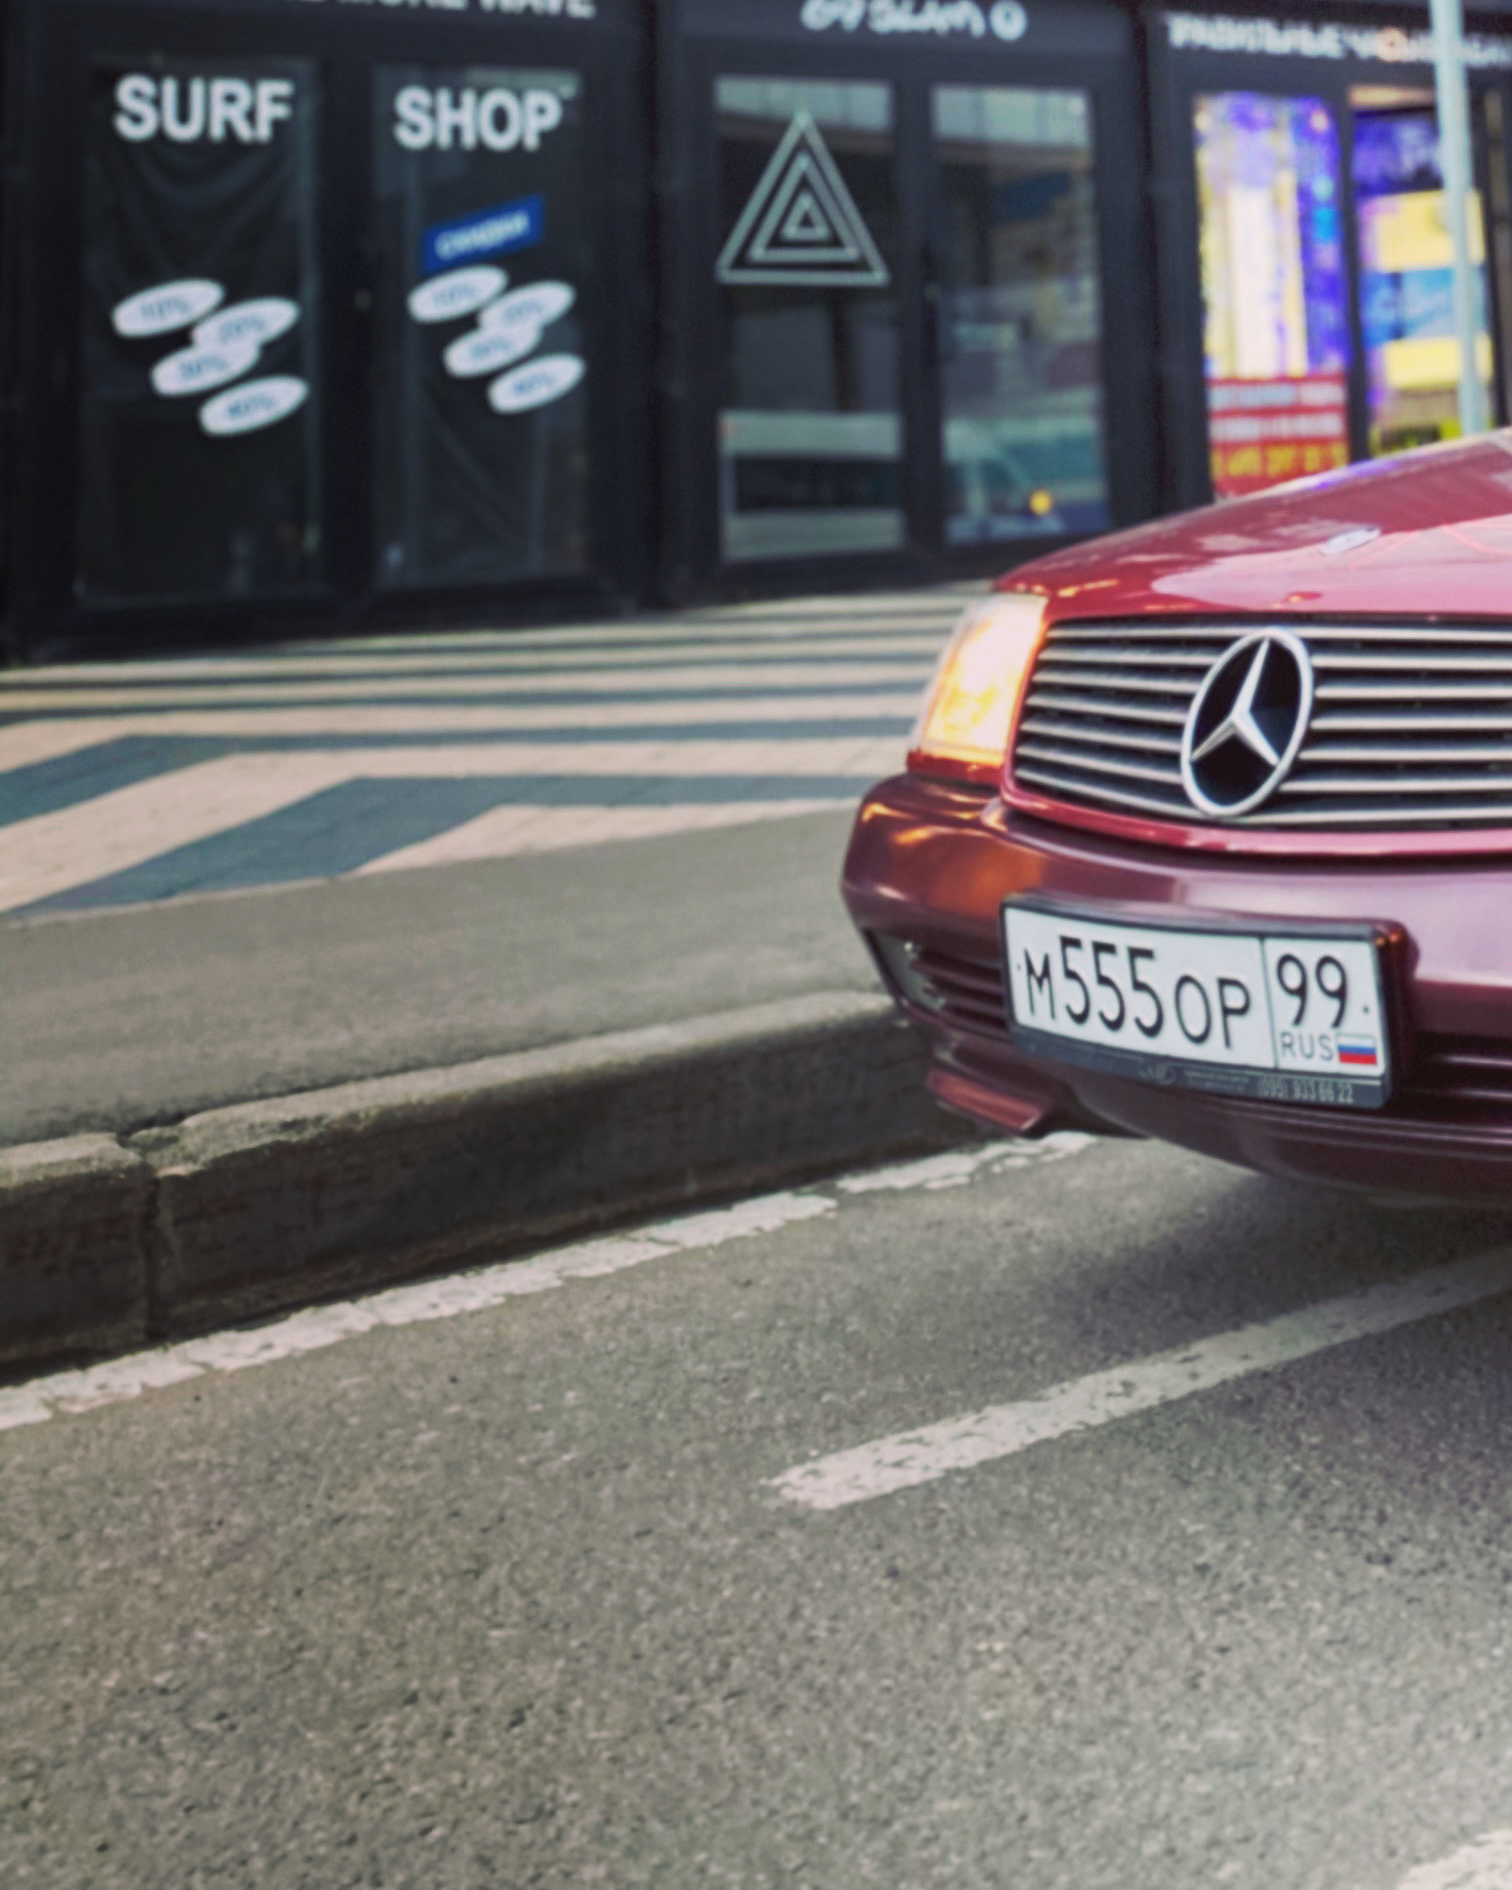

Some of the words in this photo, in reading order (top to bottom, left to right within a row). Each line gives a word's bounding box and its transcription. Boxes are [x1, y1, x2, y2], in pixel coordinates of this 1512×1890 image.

[113, 73, 294, 143] SURF
[394, 85, 563, 152] SHOP
[1276, 953, 1349, 1029] 99
[1279, 1030, 1335, 1061] RUS
